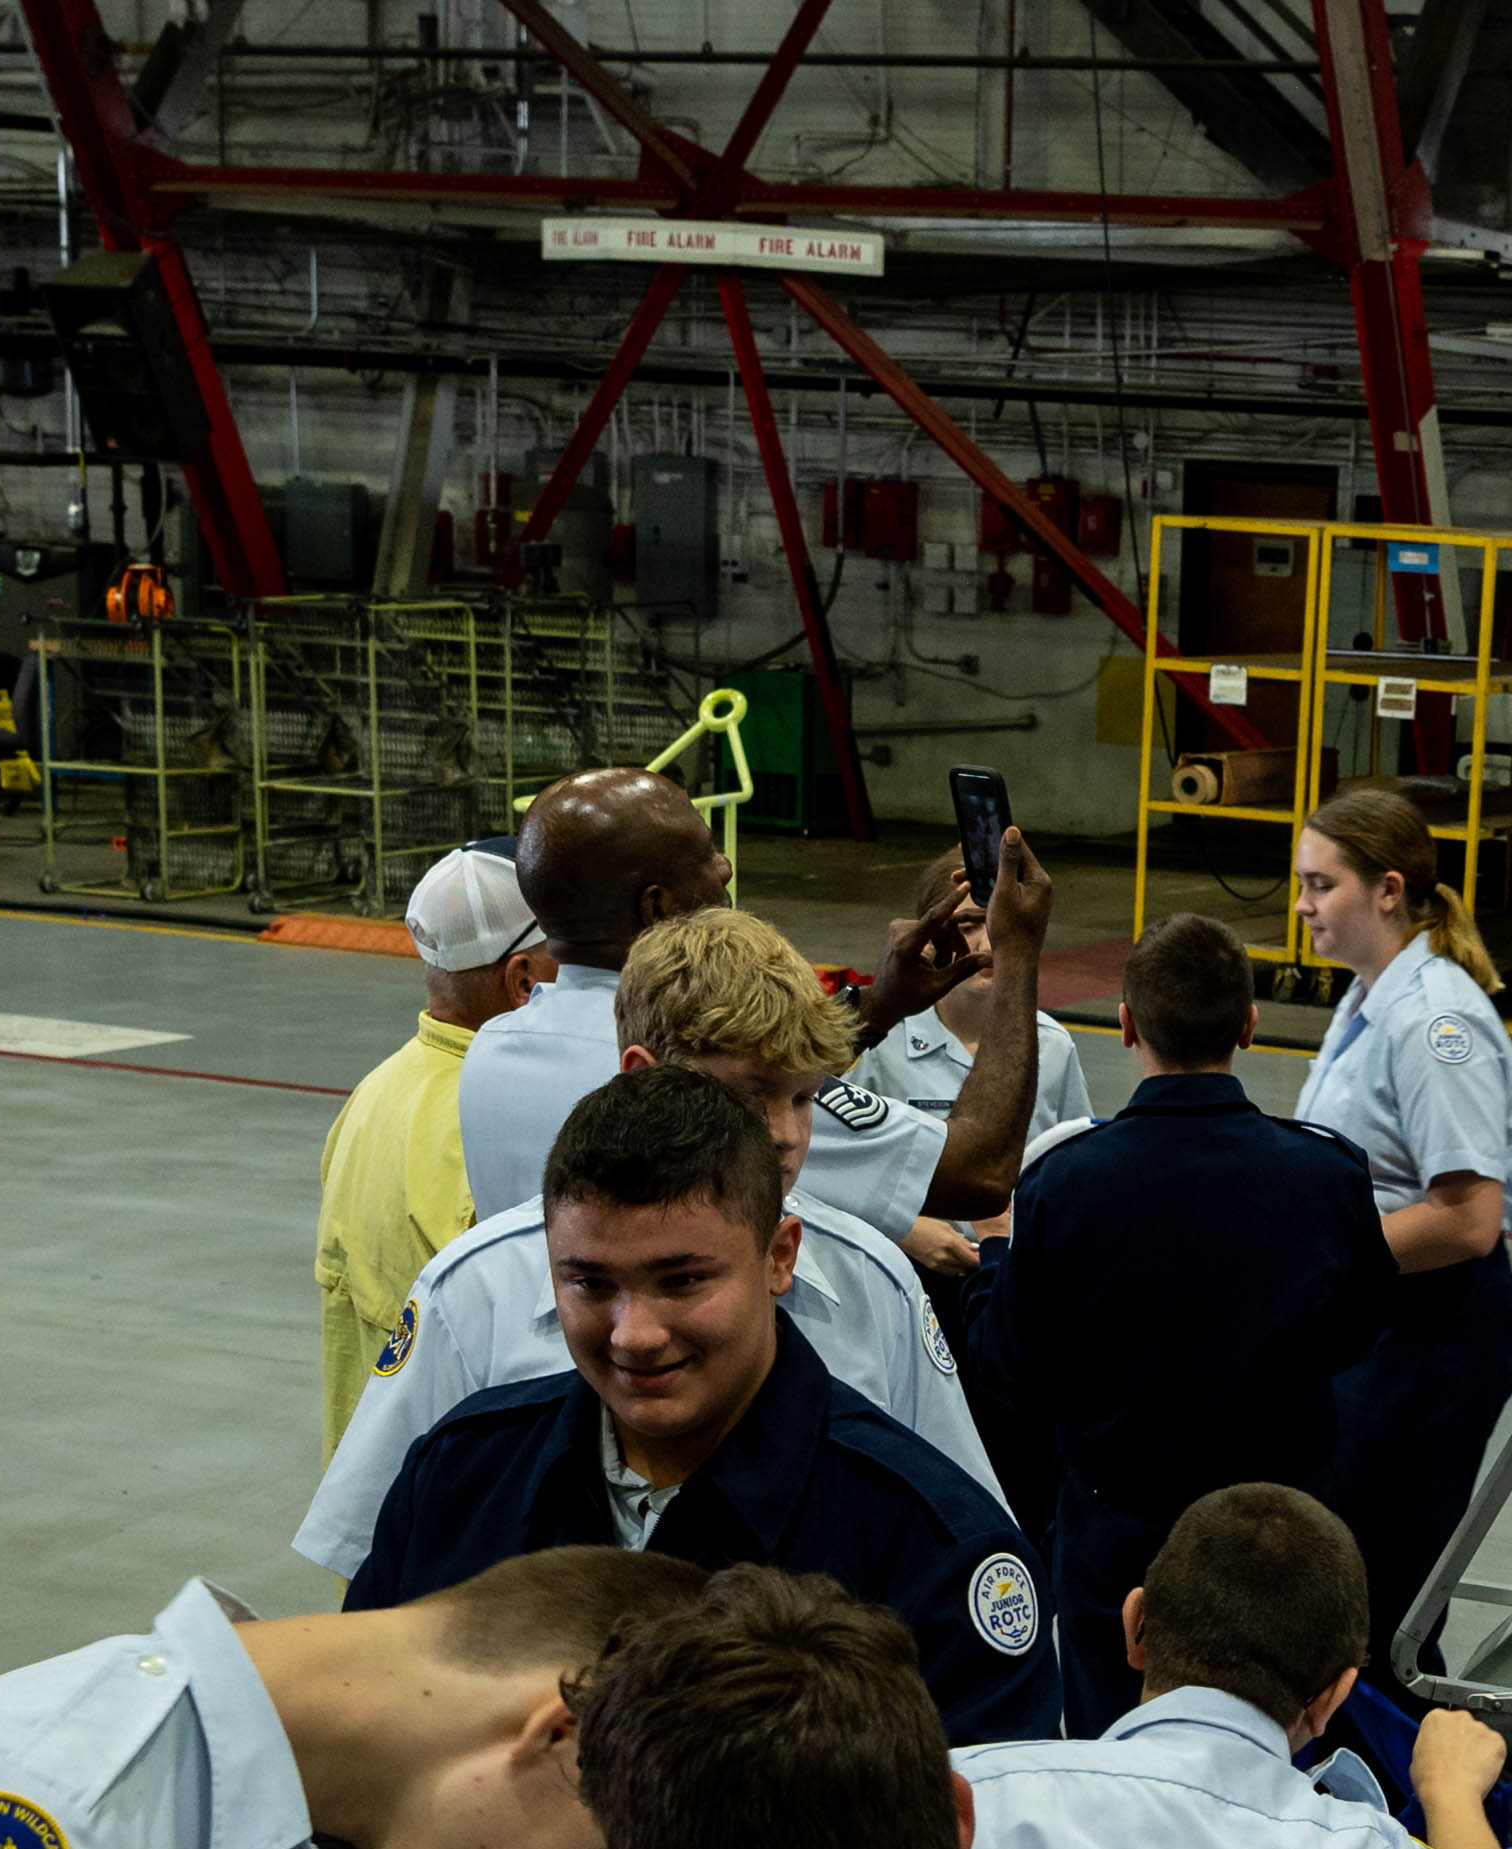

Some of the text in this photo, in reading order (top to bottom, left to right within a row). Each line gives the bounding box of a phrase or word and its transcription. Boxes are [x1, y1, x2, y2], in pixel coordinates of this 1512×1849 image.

[626, 230, 716, 250] FIRE ALARM
[759, 237, 862, 261] FIRE ALARM
[981, 1566, 1025, 1600] AIR FORCE
[991, 1594, 1024, 1613] JUNIOR
[989, 1604, 1031, 1630] ROTC
